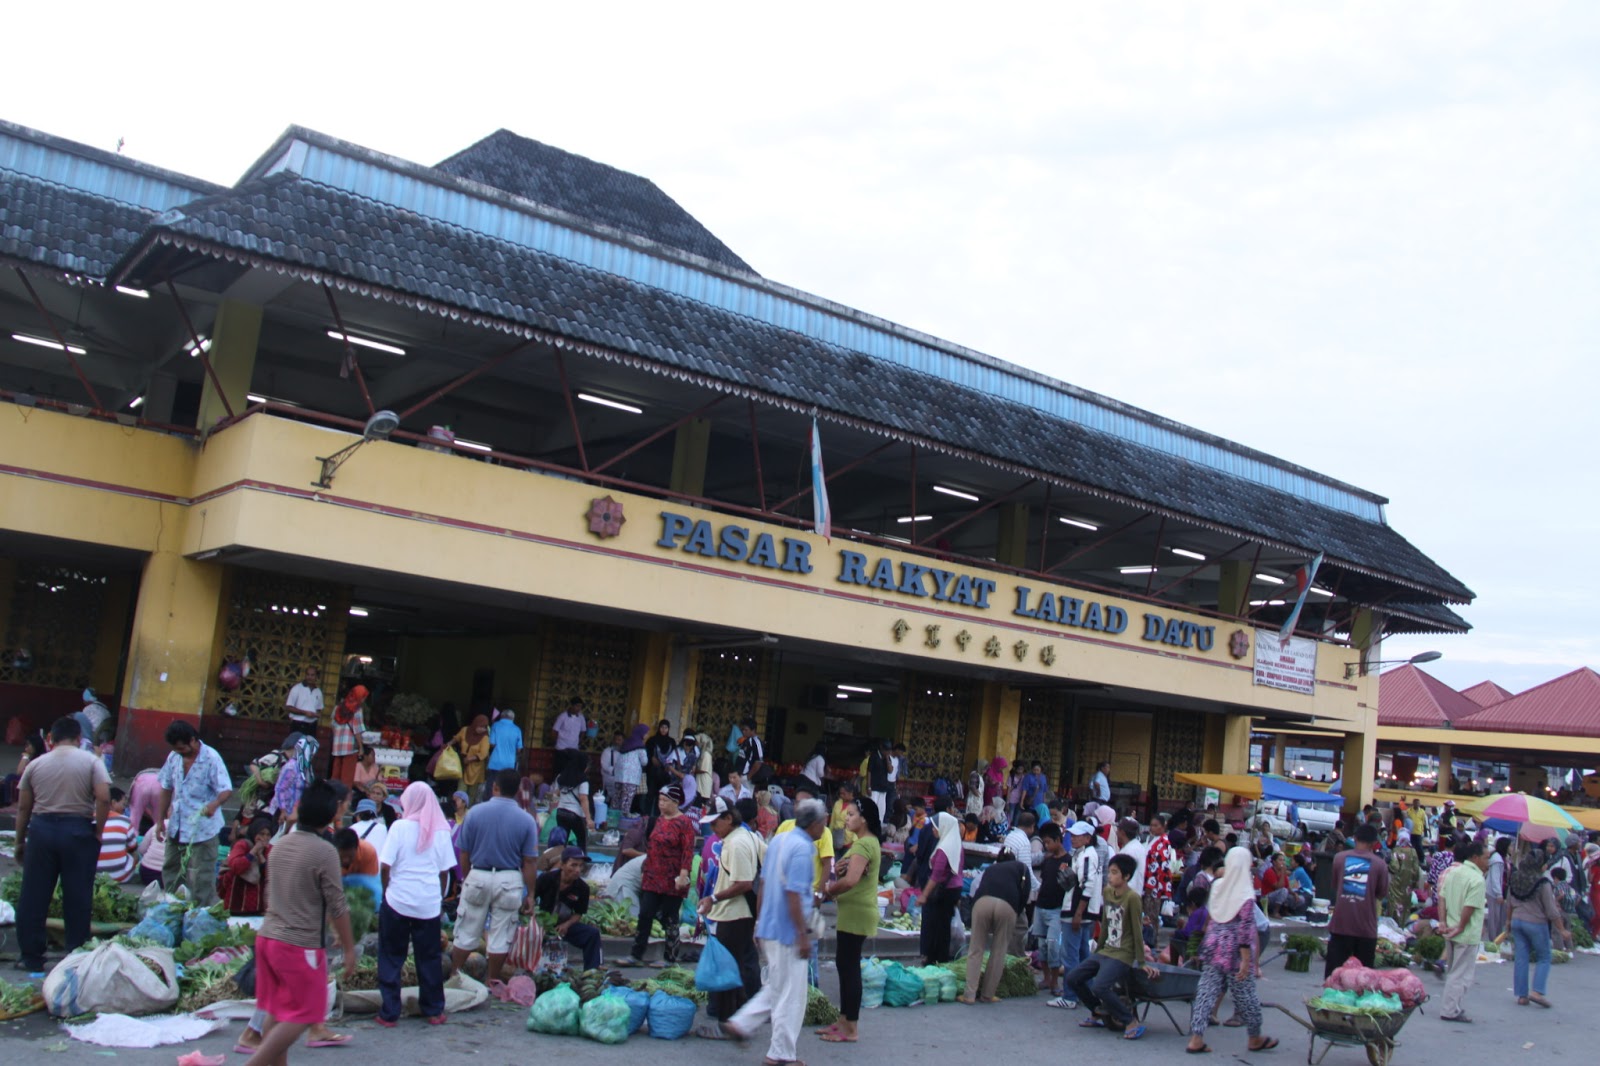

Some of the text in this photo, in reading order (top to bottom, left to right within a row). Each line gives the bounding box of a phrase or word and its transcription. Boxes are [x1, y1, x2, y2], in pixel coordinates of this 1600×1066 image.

[657, 511, 1216, 651] PASAR RAKYAT LAHAD DATU
